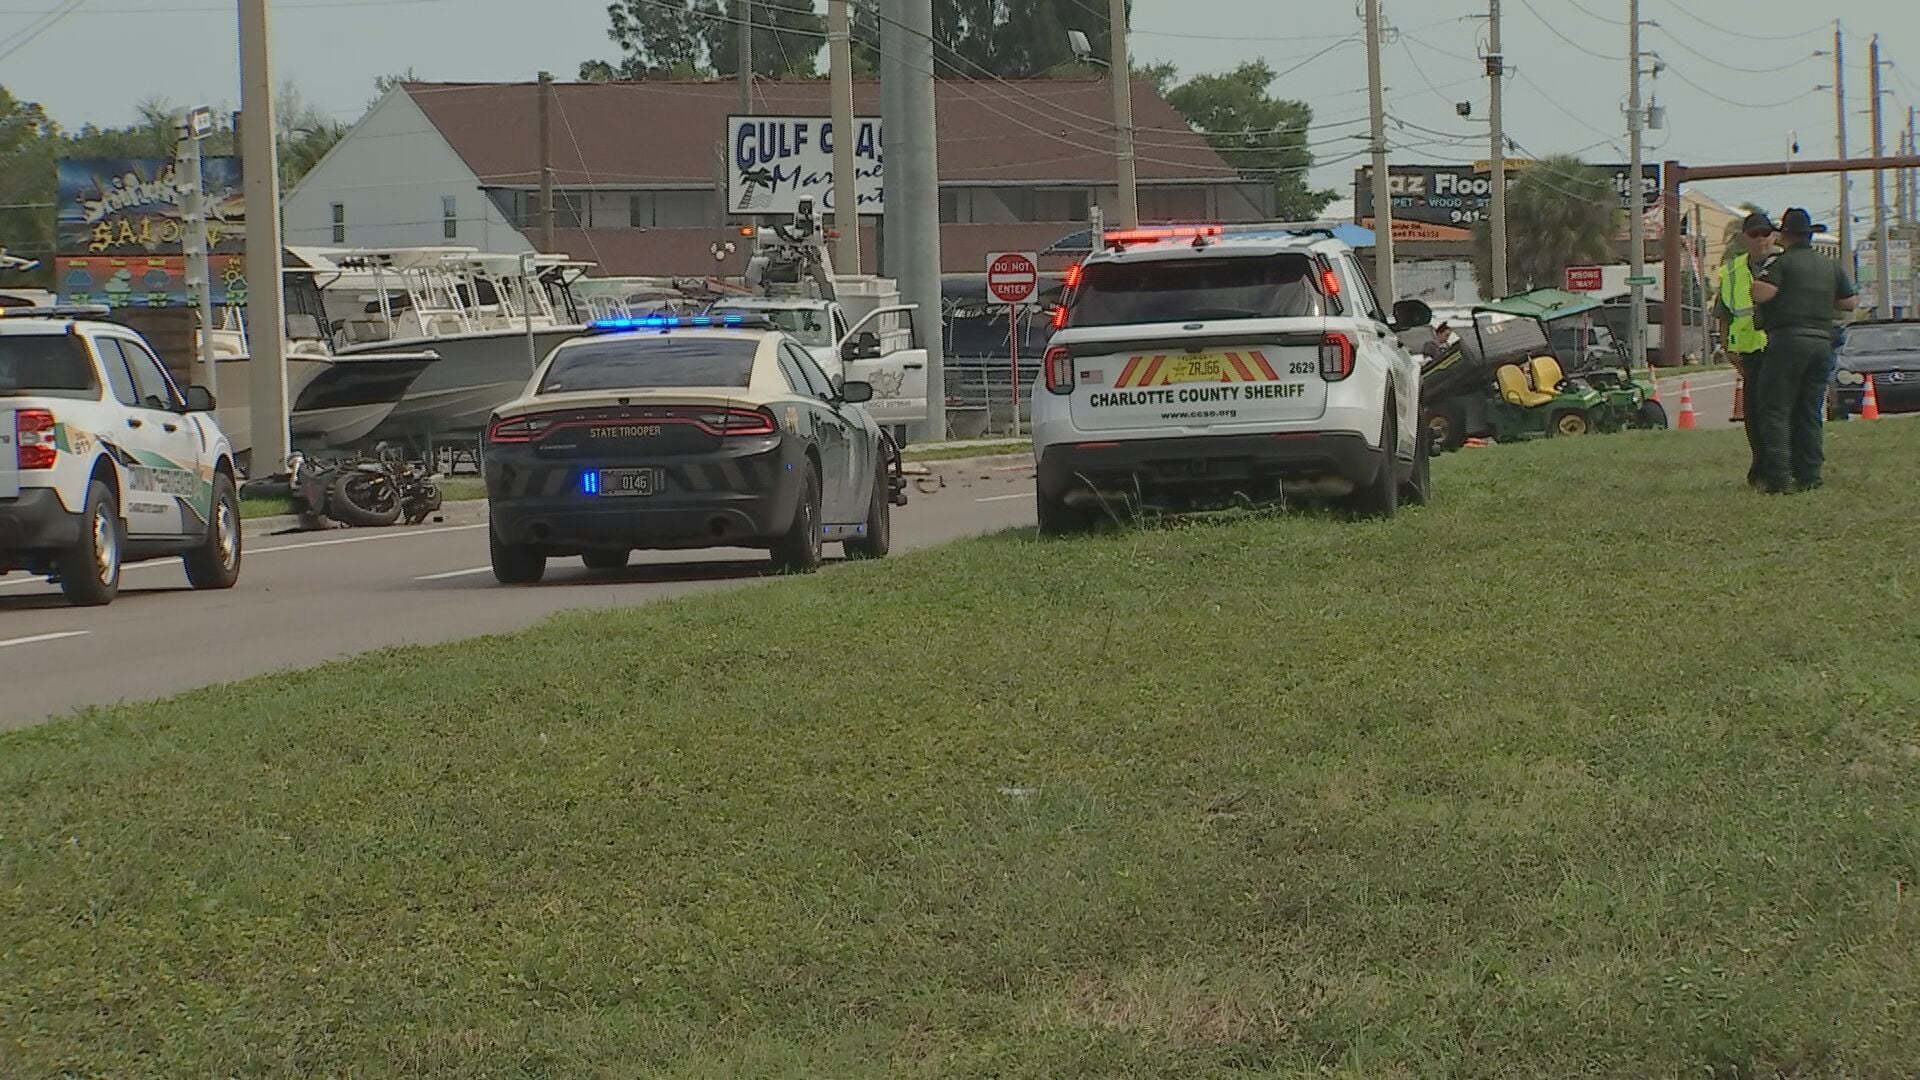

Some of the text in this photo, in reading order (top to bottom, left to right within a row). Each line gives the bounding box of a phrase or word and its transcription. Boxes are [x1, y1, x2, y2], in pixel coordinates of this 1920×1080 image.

[736, 122, 808, 171] GULF
[771, 164, 884, 194] Marne
[1429, 198, 1462, 208] WOOD
[994, 261, 1030, 272] DO NOT
[1570, 271, 1600, 280] WRONG
[998, 284, 1029, 295] ENTER
[1576, 280, 1594, 288] WAY
[1289, 362, 1315, 375] 2629
[1089, 383, 1305, 408] CHARLOTTE COUNTY SHERIFF
[1160, 409, 1237, 420] www.ccso.org
[590, 425, 661, 438] STATE TROOPER
[622, 475, 647, 489] 0146
